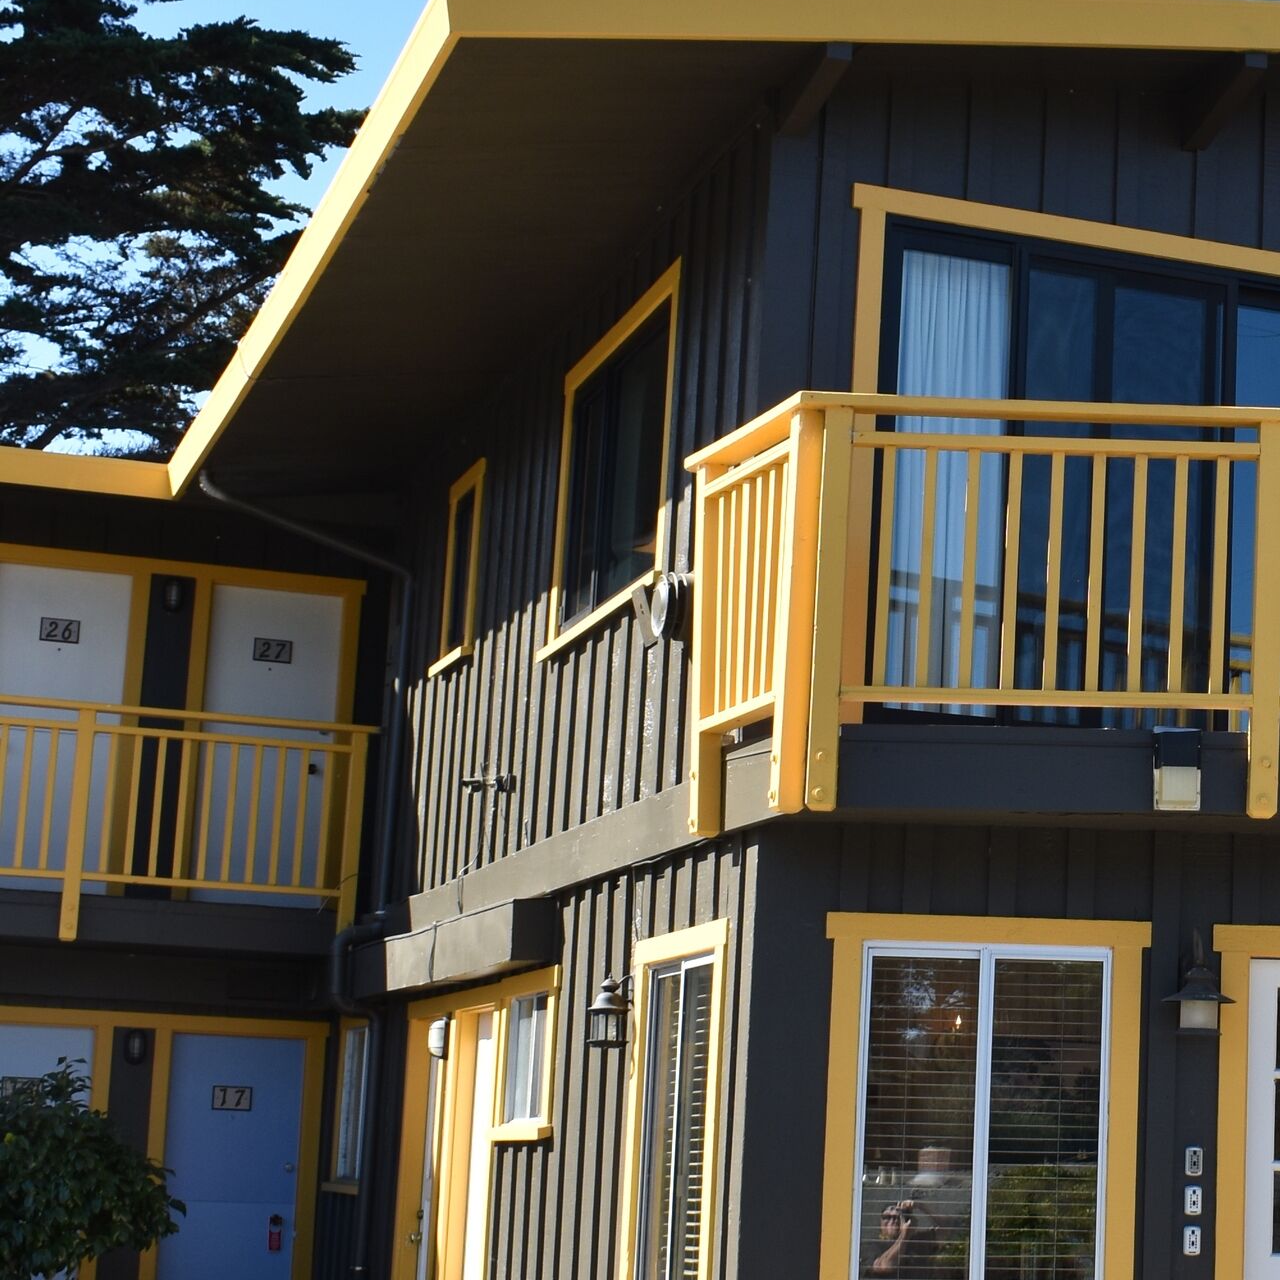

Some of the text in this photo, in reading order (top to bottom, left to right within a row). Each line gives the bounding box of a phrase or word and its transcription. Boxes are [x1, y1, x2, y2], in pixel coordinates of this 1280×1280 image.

[45, 621, 73, 641] 26
[259, 641, 287, 660] 27
[219, 1087, 246, 1108] 17
